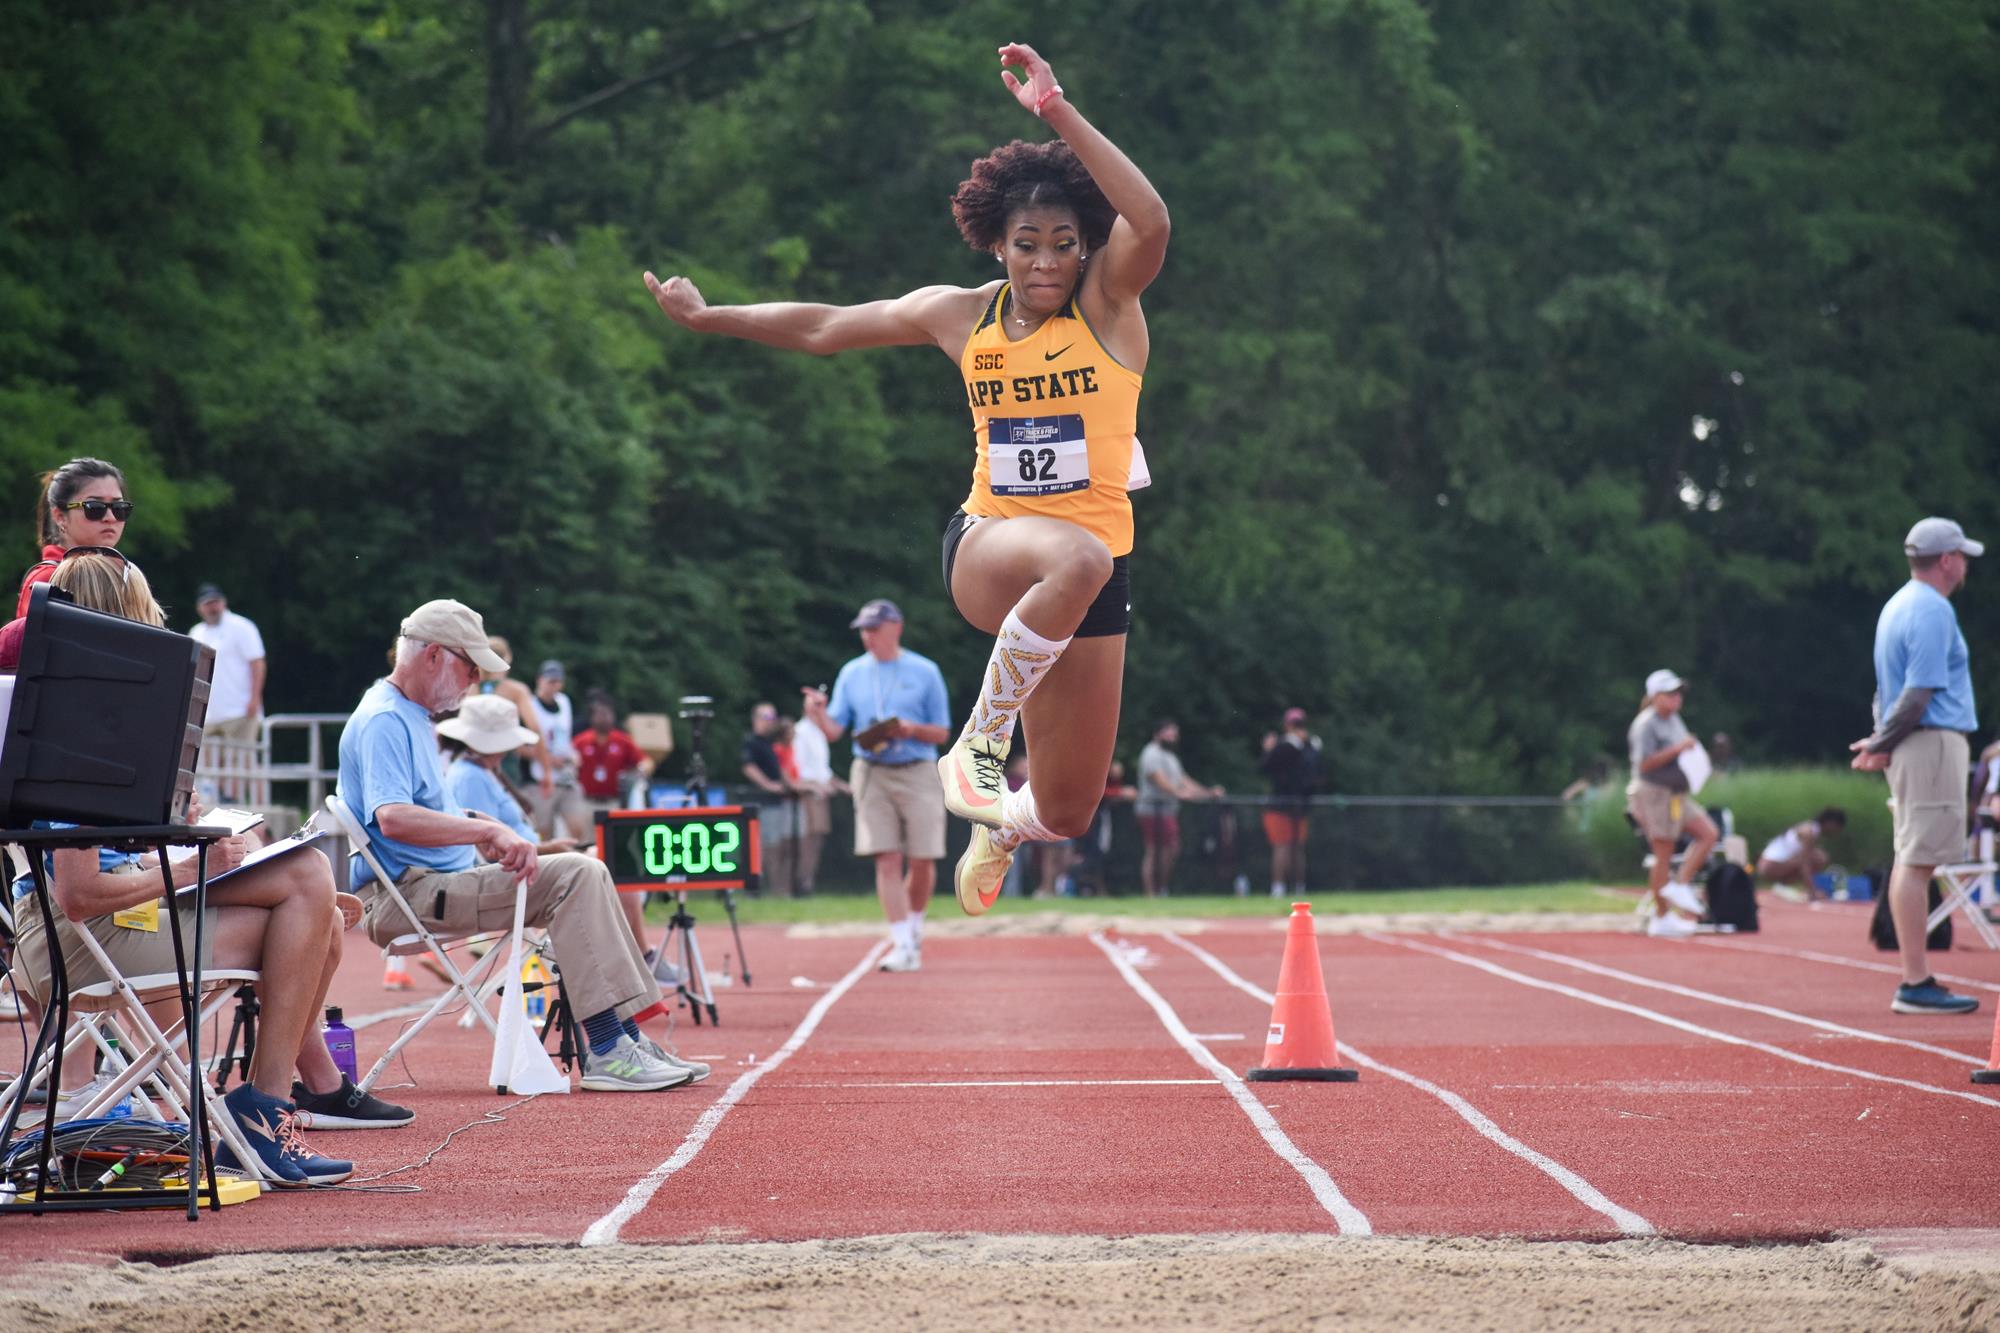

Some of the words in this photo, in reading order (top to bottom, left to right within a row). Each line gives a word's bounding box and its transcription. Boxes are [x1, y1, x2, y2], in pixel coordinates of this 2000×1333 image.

[974, 353, 1004, 371] SBC
[969, 380, 1004, 408] APP
[1012, 366, 1099, 403] STATE
[1018, 448, 1058, 482] 82
[644, 822, 739, 875] 0:02
